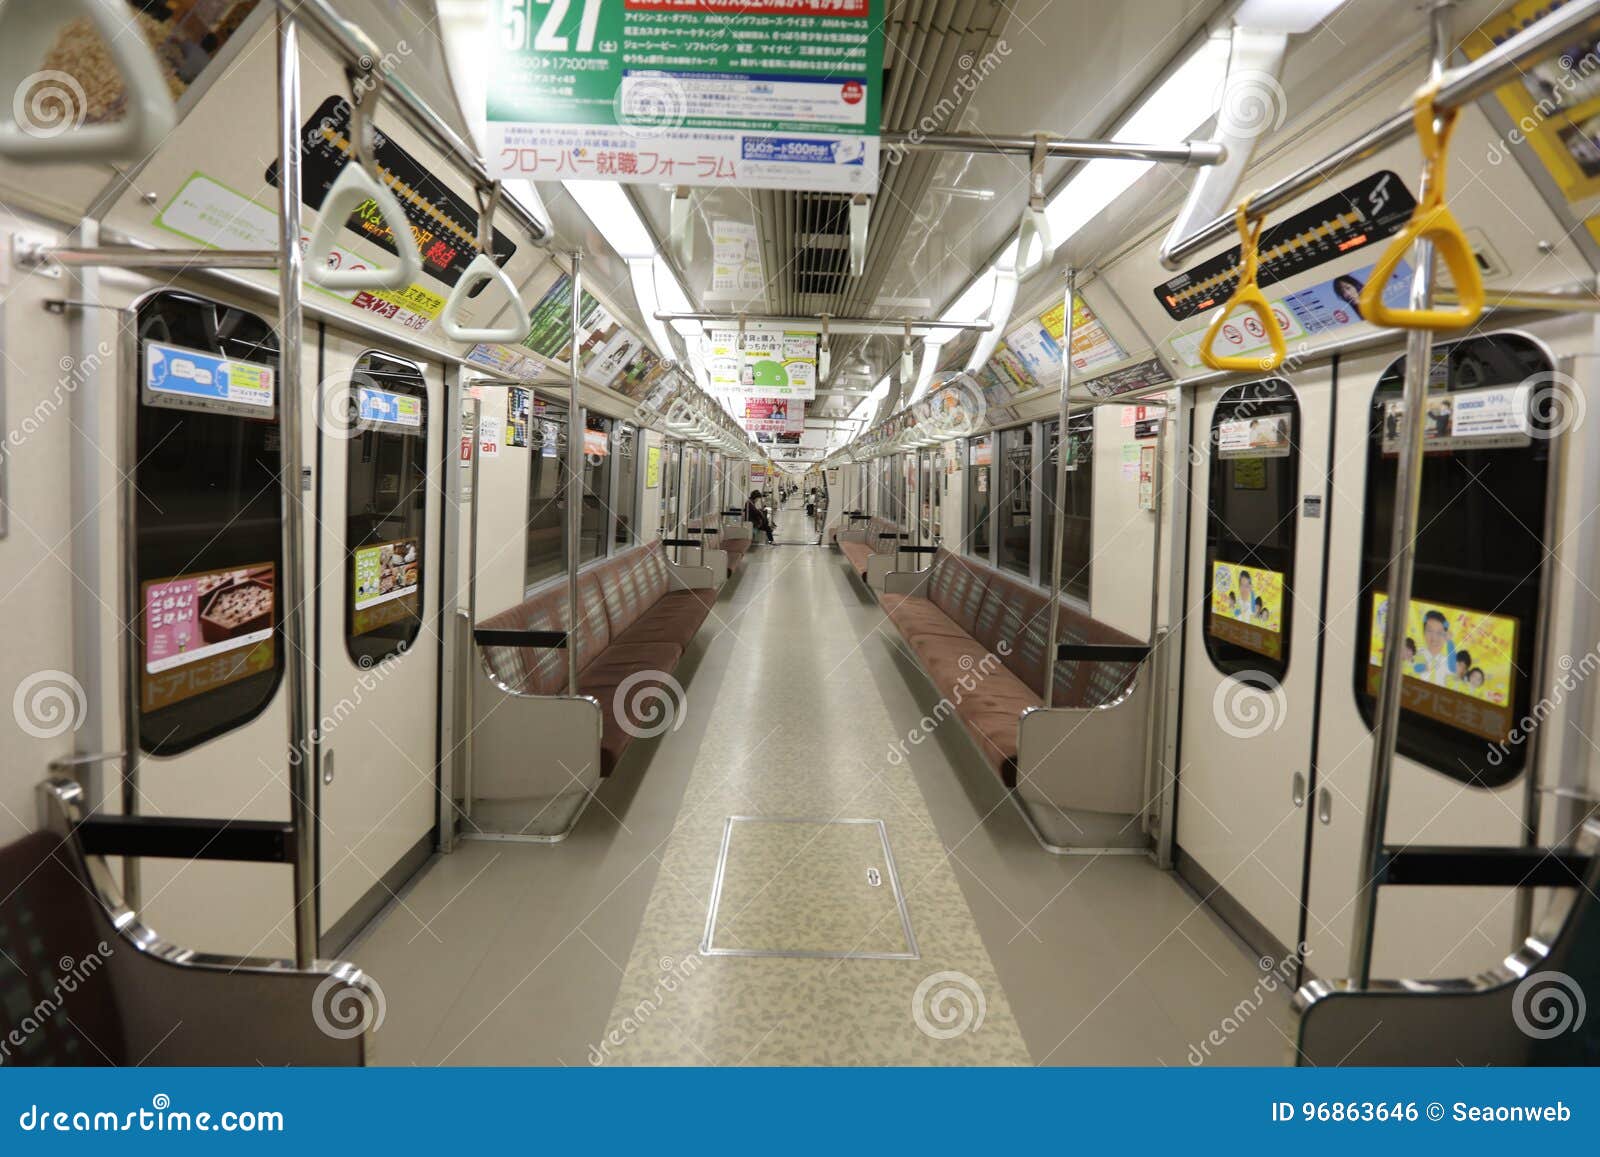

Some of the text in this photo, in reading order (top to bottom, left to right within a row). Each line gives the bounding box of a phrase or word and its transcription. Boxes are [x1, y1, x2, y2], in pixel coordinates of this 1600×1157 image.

[501, 148, 737, 179] クローバー就職フォーラム
[747, 343, 782, 351] っちが得?
